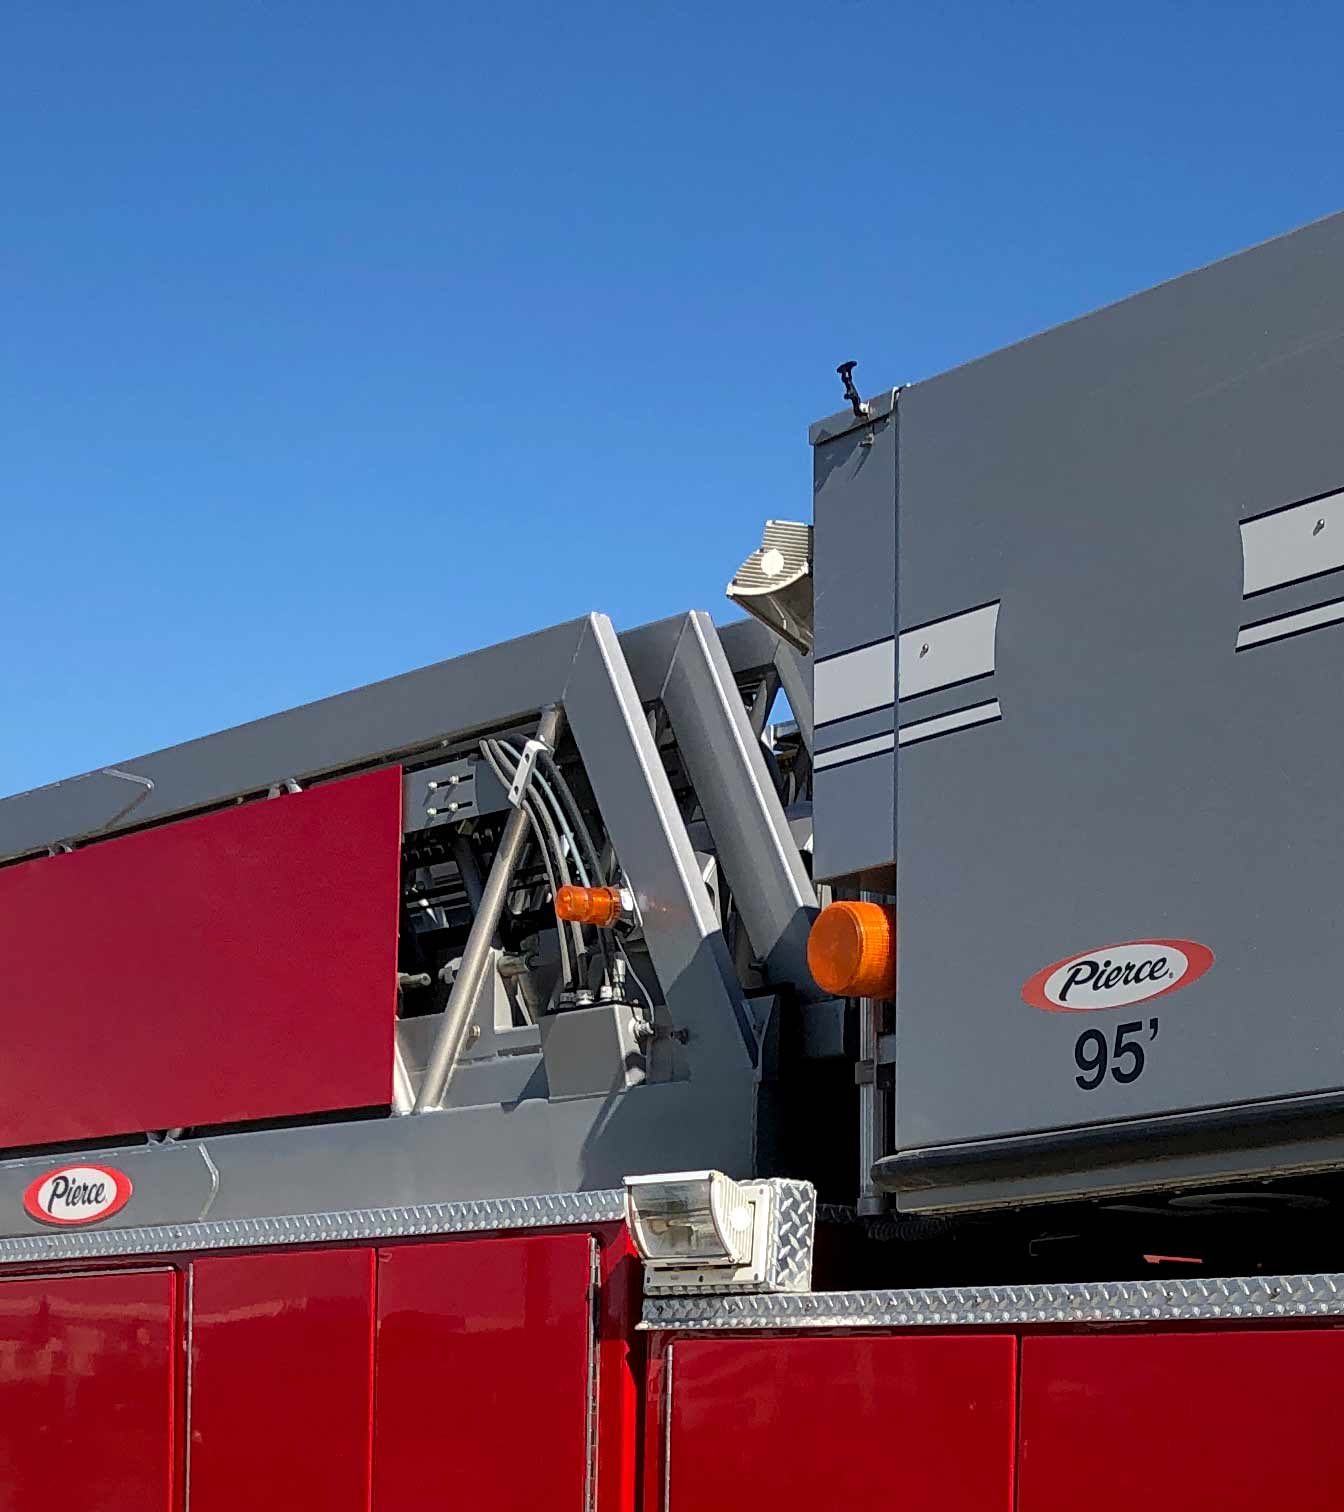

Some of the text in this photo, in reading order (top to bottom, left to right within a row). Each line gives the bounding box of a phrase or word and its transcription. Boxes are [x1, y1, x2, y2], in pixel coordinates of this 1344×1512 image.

[1058, 957, 1170, 1001] Pierce
[1074, 1017, 1159, 1091] 95'
[47, 1175, 107, 1214] Pierce
